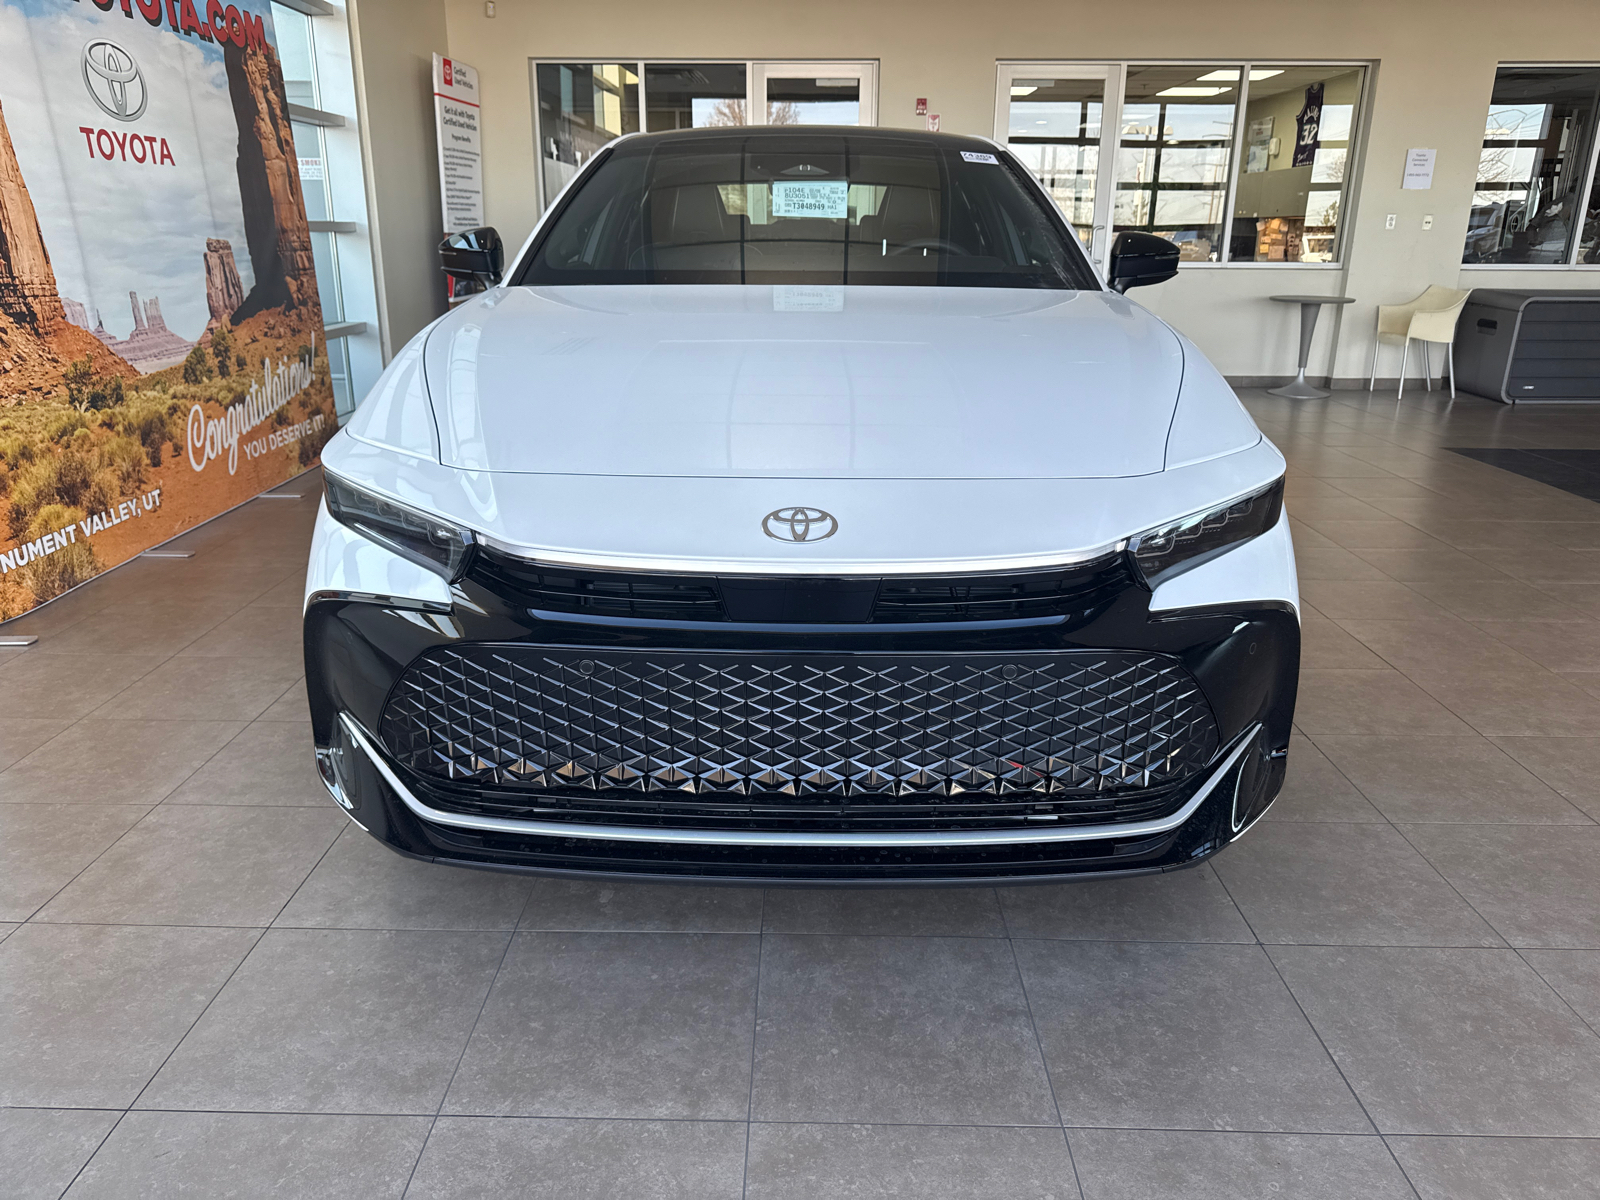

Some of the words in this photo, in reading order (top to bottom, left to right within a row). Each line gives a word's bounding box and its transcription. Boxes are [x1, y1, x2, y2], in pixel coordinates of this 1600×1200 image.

[73, 0, 268, 55] TA.COM
[79, 126, 176, 166] TOYOTA
[443, 116, 457, 127] Certified
[465, 122, 477, 132] Vehicles
[1299, 123, 1318, 145] 32
[187, 331, 316, 476] Congratulations!
[243, 437, 267, 460] YOU
[268, 421, 313, 451] DESERVE
[312, 413, 326, 432] IT!
[0, 523, 77, 574] NUMENT
[79, 498, 142, 538] VALLEY,
[142, 488, 161, 511] UT
